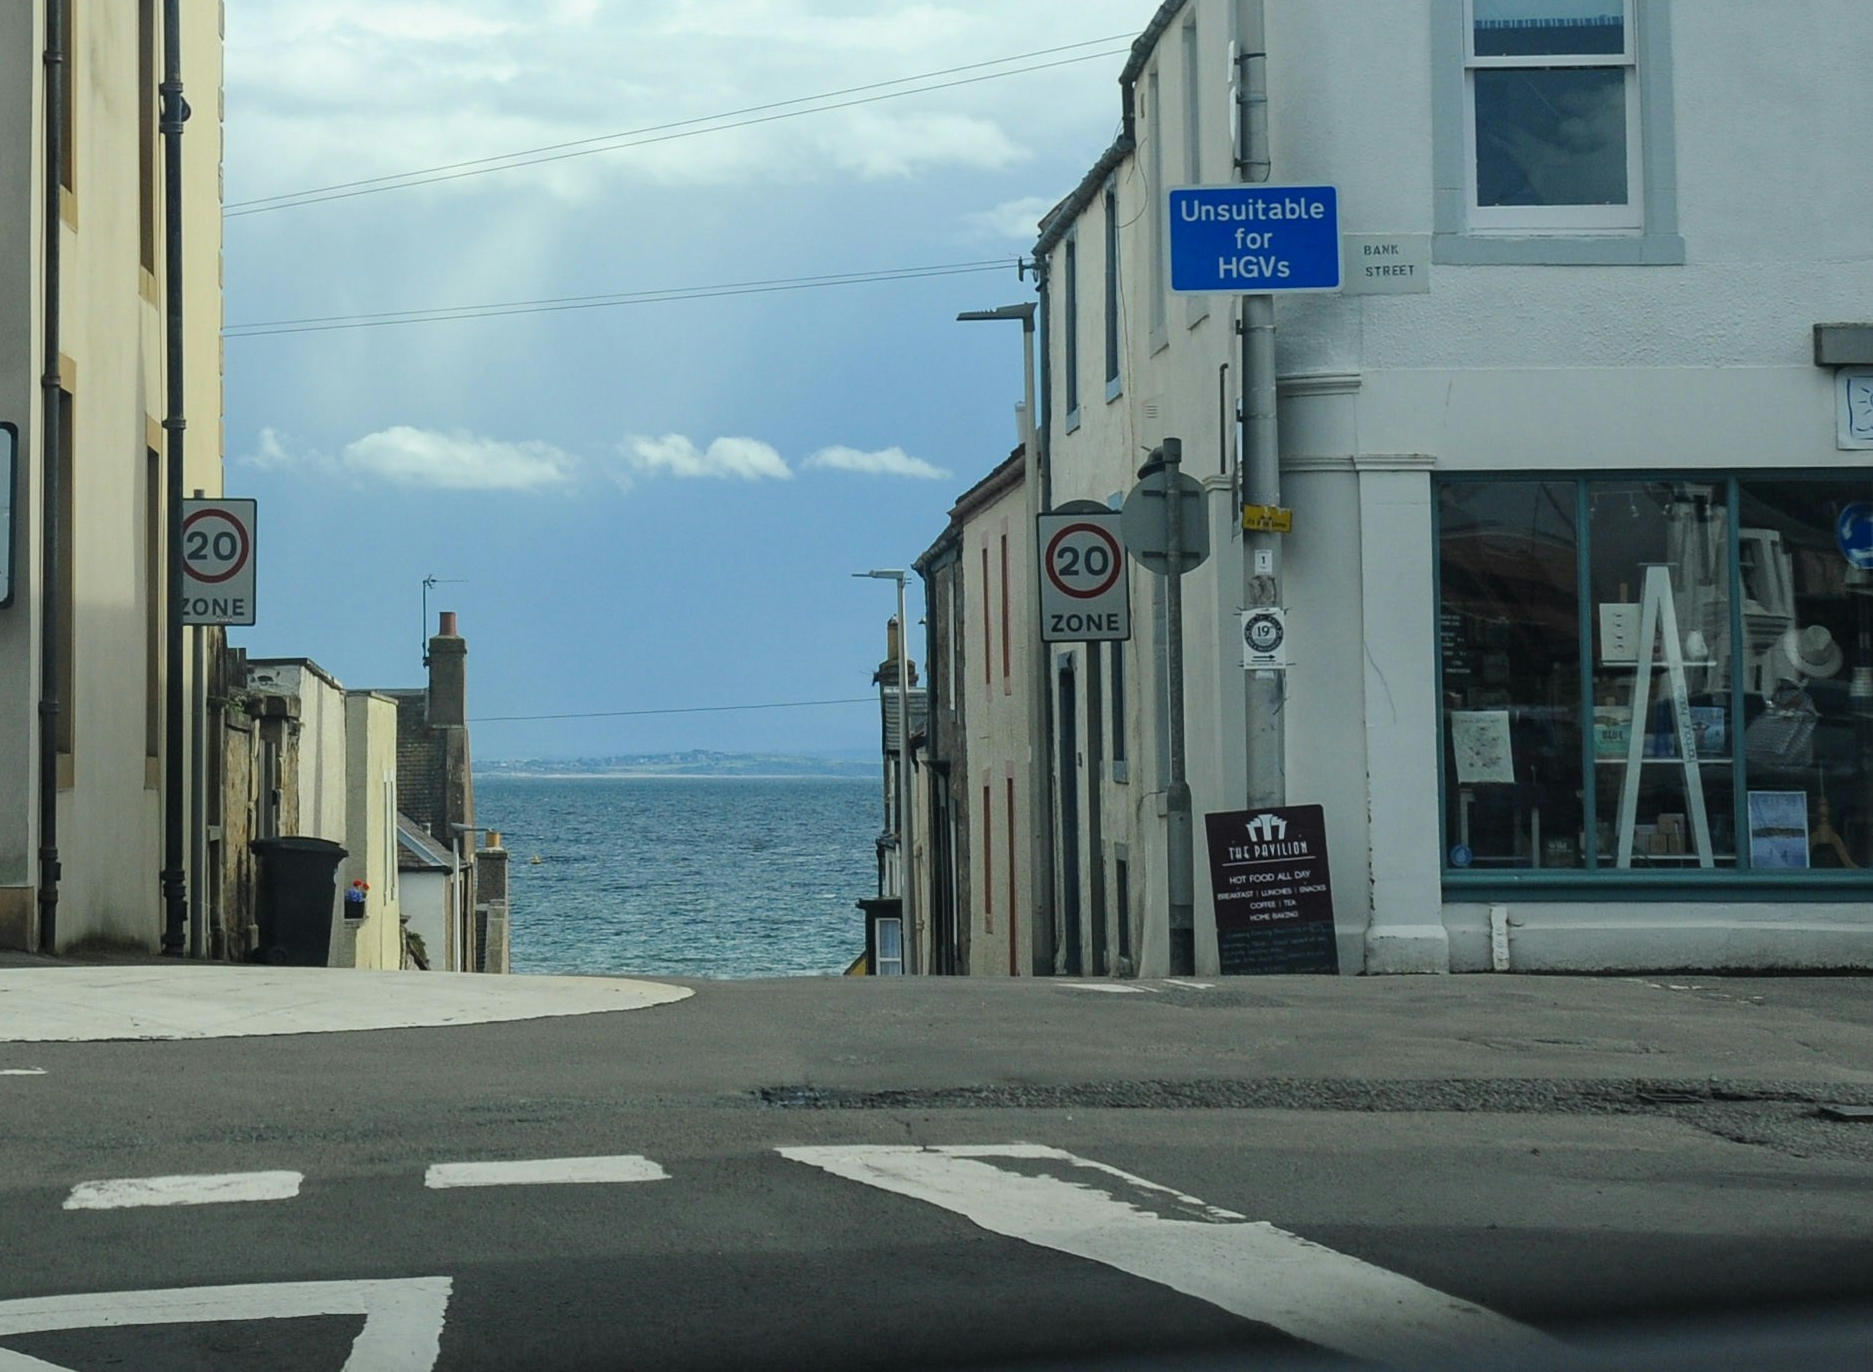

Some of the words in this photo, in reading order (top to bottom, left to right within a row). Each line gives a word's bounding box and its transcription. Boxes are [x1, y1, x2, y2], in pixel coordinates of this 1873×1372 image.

[1181, 198, 1324, 221] Unsuitable
[1235, 228, 1273, 249] for
[1364, 245, 1399, 255] BANK
[1218, 256, 1290, 278] HGVs
[1366, 265, 1414, 277] STREET
[187, 531, 237, 561] 20
[1057, 546, 1109, 576] 20
[183, 598, 244, 616] ZONE
[1051, 614, 1119, 632] ZONE
[1257, 625, 1270, 637] 19
[1229, 846, 1250, 860] THE
[1254, 841, 1308, 858] PAVILION
[1230, 875, 1246, 884] HOT
[1249, 873, 1274, 883] FOOD
[1278, 871, 1292, 881] ALL
[1295, 870, 1311, 879] DAY
[1217, 890, 1253, 900] BREAKFAST
[1261, 887, 1292, 897] LUNCHES
[1250, 901, 1276, 909] COFFEE
[1284, 899, 1296, 907] TEA
[1250, 913, 1270, 921] HOME
